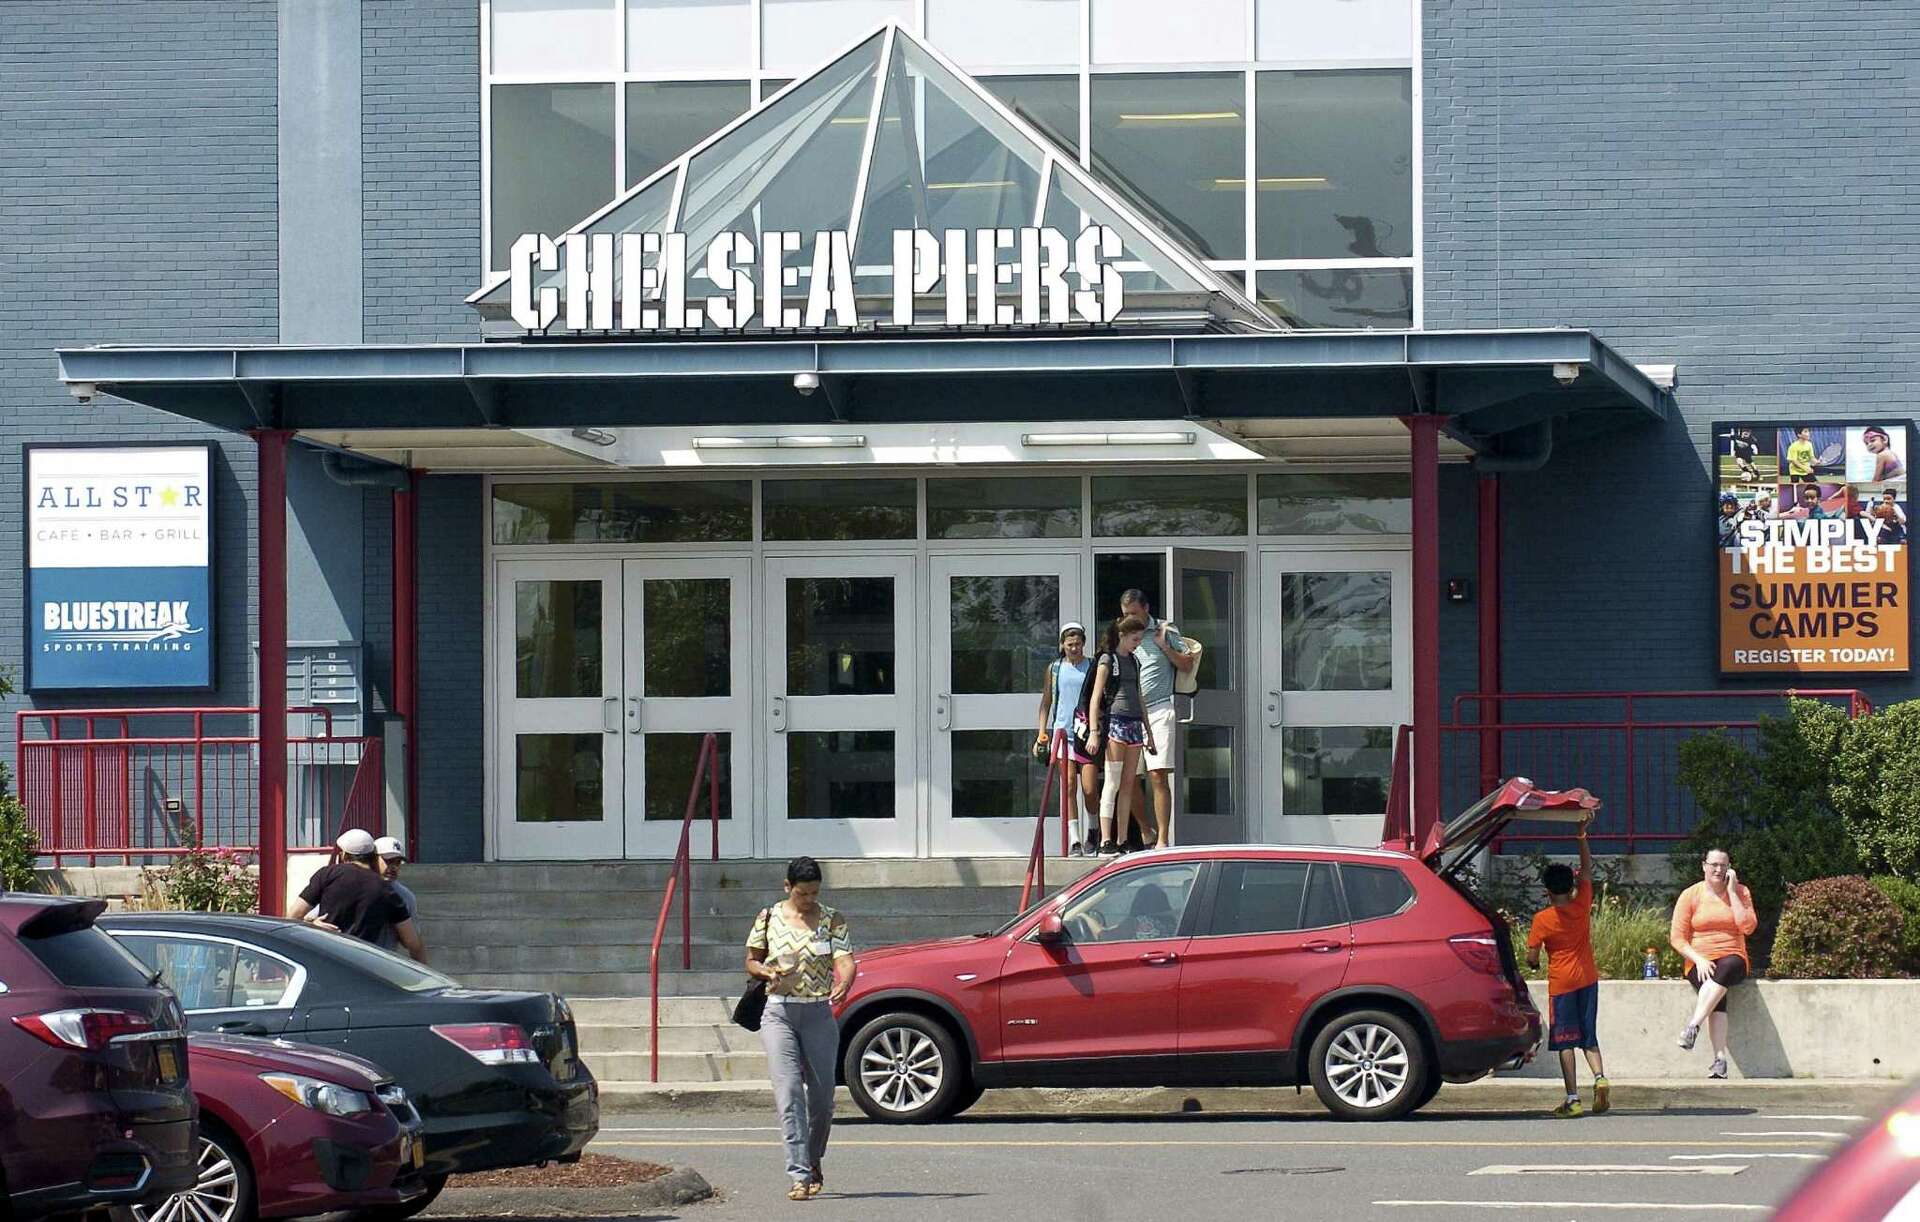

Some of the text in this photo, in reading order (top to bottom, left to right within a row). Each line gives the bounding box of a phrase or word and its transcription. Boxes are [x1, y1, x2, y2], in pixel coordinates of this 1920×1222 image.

[510, 225, 1125, 330] CHELSEA PIERS
[100, 529, 133, 541] BAR
[154, 528, 201, 541] GRILL
[1740, 518, 1885, 547] SIMPLY
[1725, 544, 1902, 575] THE BEST
[1728, 582, 1899, 610] SUMMER
[43, 601, 190, 631] BLUESTREAK
[1750, 611, 1880, 640] CAMPS
[43, 642, 192, 653] SPORTS TRAINING
[1733, 647, 1896, 665] REGISTER TODAY!
